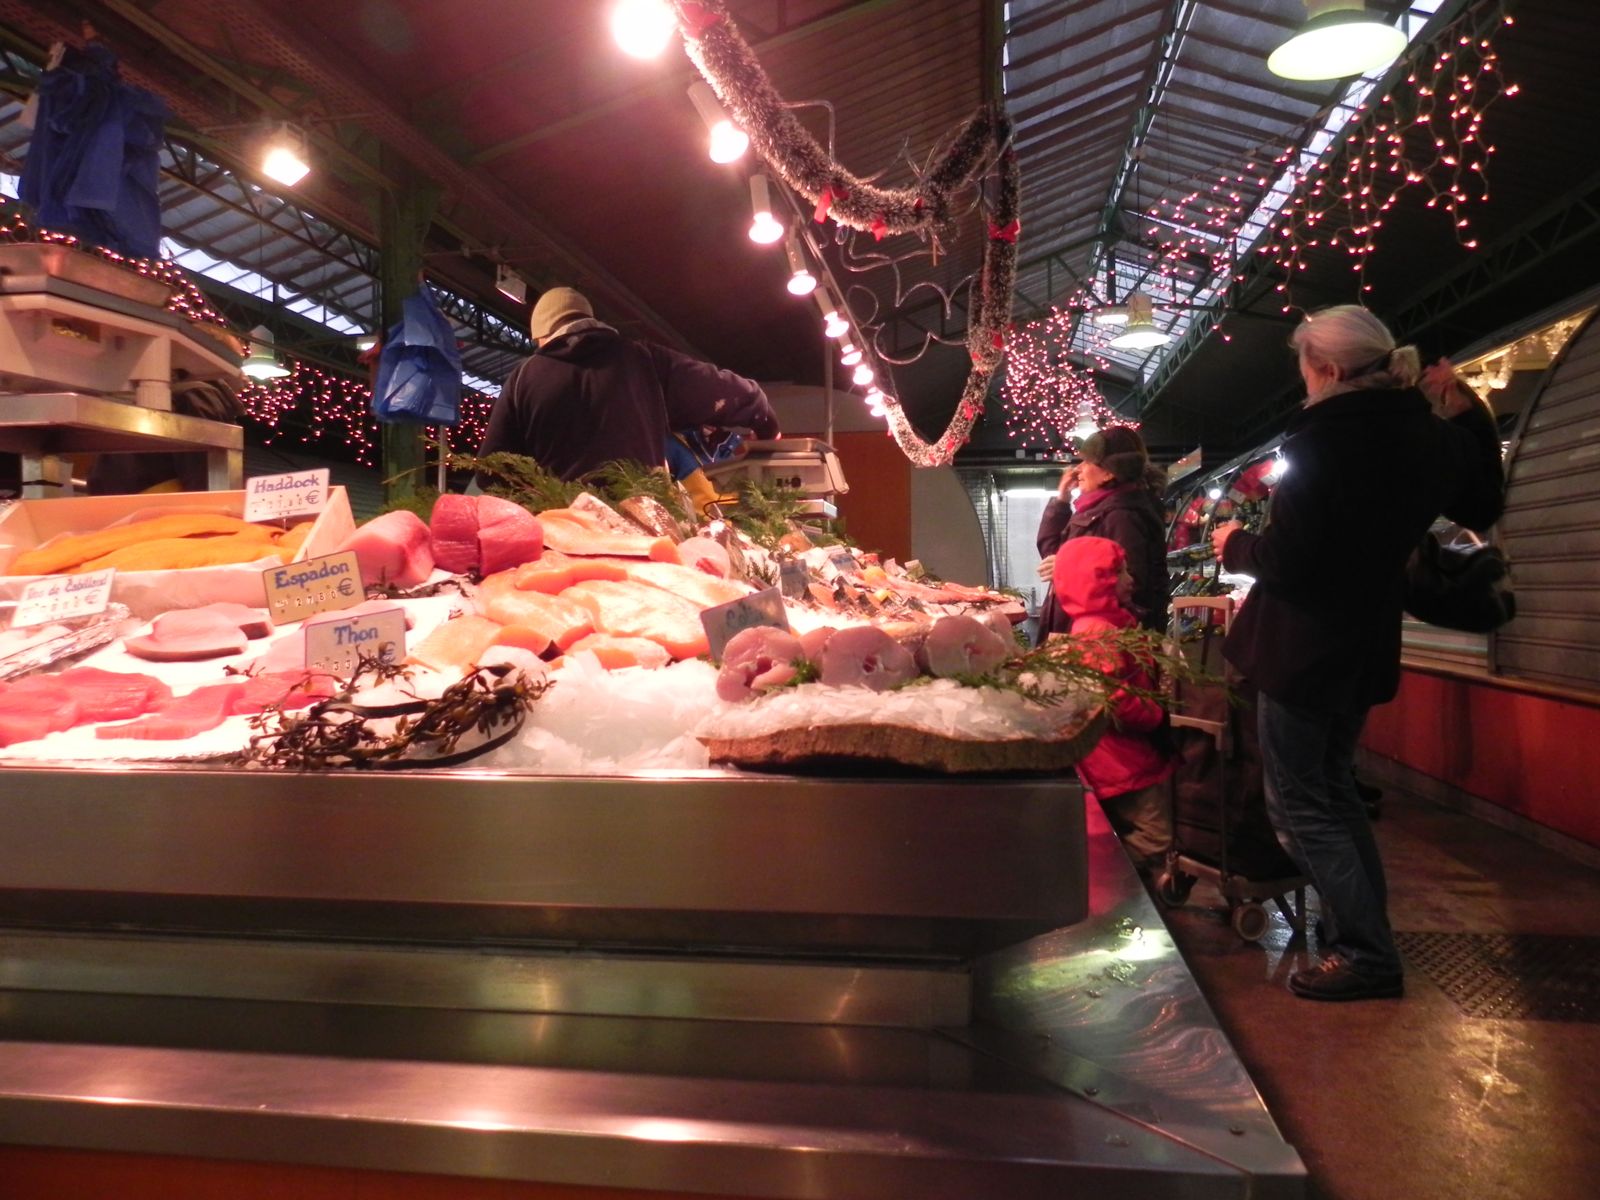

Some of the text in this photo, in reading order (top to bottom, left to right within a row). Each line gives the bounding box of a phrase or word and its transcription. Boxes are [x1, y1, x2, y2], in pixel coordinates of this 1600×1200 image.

[254, 473, 320, 494] Haddock
[274, 561, 350, 589] Espadon
[334, 624, 379, 645] Thon
